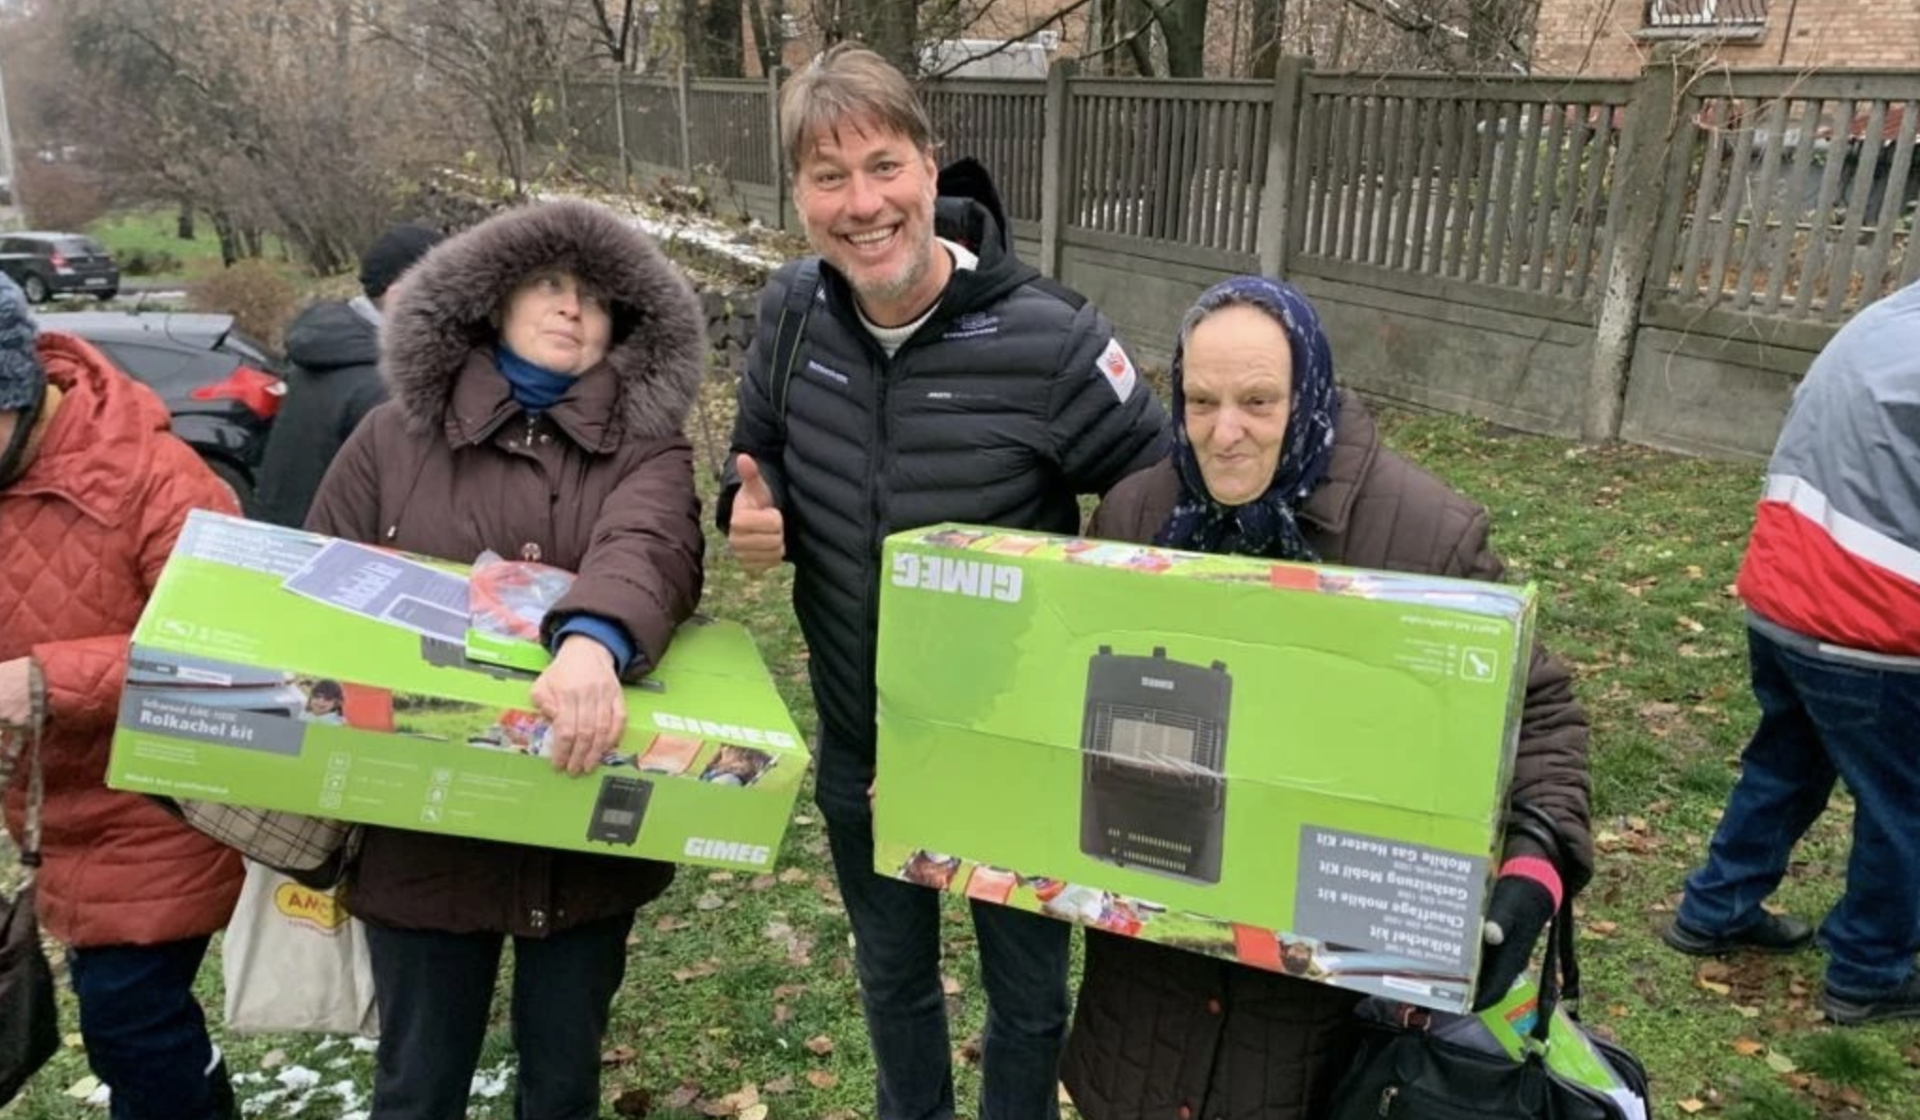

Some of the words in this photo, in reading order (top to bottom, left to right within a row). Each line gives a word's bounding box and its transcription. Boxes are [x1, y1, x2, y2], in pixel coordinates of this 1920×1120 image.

[892, 551, 1023, 602] GIMEG
[140, 709, 226, 737] Rolkachel
[229, 724, 254, 741] kit
[652, 711, 797, 748] GIMEG
[1316, 832, 1337, 848] Kit
[1341, 836, 1388, 857] Heater
[683, 837, 770, 865] GIMEG
[1392, 848, 1418, 863] Gas
[1319, 859, 1340, 876] Kit
[1422, 852, 1472, 874] Mobile
[1343, 864, 1383, 884] Mobil
[1318, 887, 1337, 903] kit
[1387, 871, 1469, 901] Gasheizung
[1341, 892, 1389, 909] mobile
[1392, 901, 1465, 929] Chauffage
[1369, 925, 1390, 941] kit
[1393, 928, 1462, 956] Rolkachel
